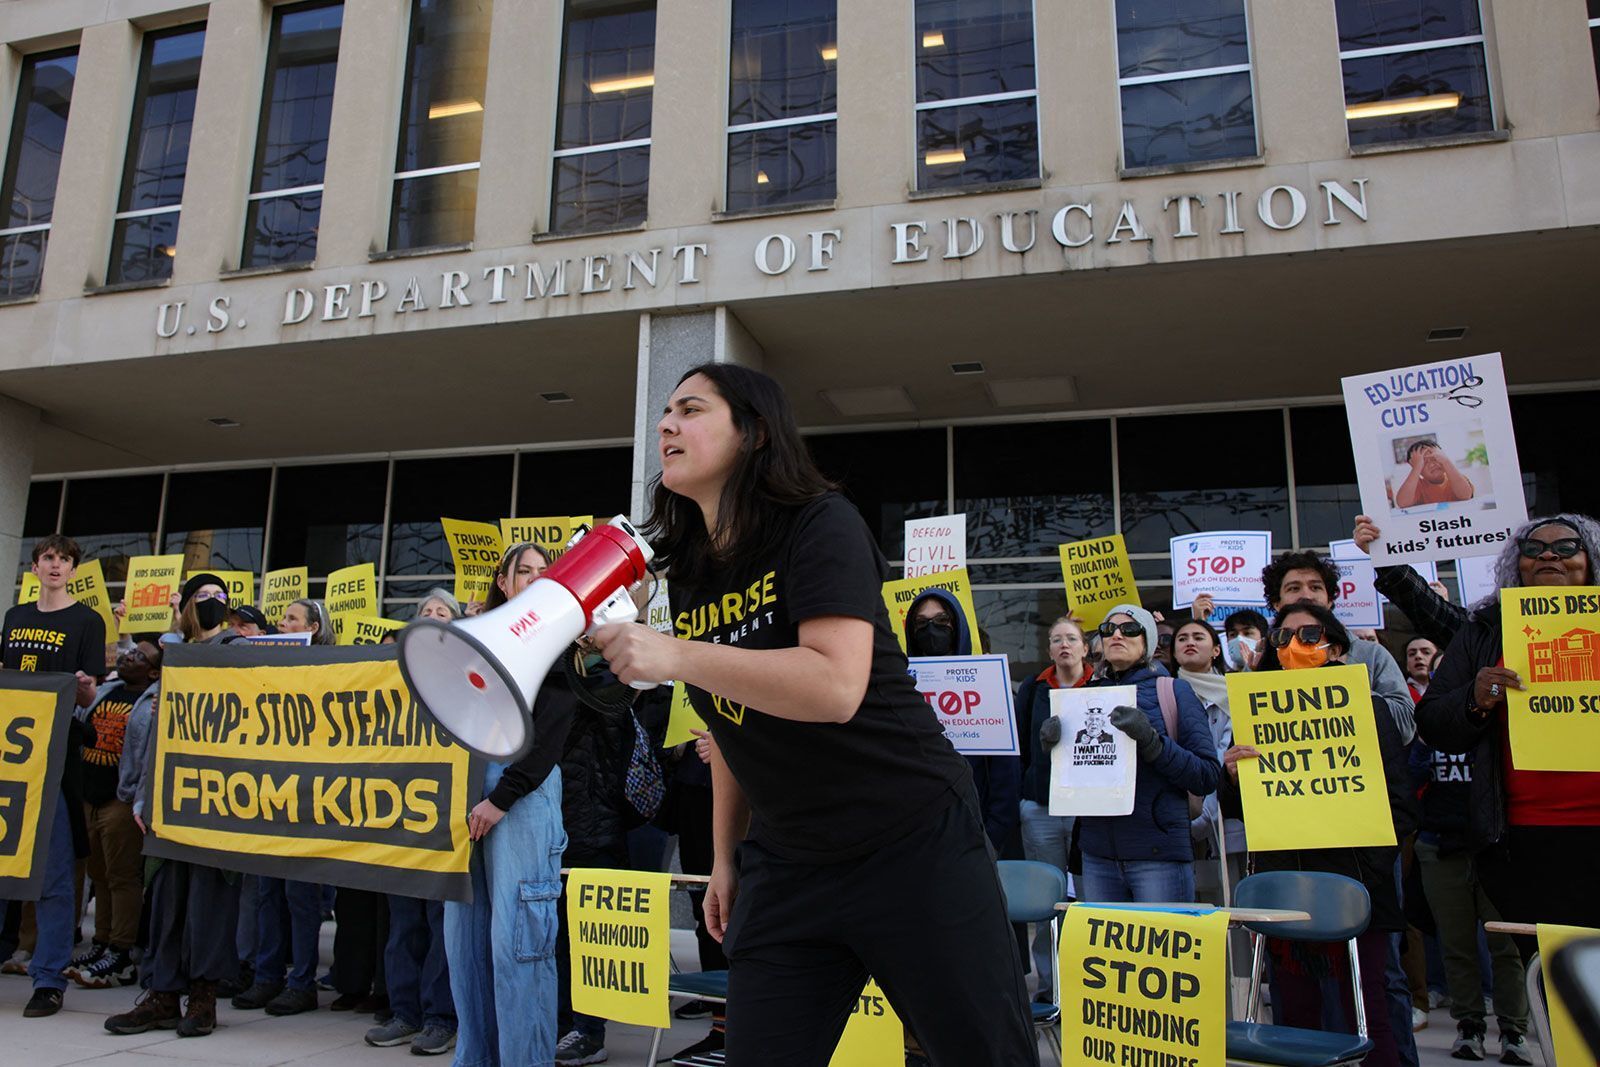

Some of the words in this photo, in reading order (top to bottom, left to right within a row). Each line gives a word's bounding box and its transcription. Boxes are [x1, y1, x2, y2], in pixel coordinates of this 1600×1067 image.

[155, 296, 247, 339] U.S.
[282, 242, 709, 326] DEPARTMENT
[754, 229, 842, 277] OF
[890, 178, 1370, 265] EDUCATION
[1363, 362, 1475, 407] EDUCATION
[1380, 402, 1430, 429] CUTS
[511, 525, 563, 544] FUND
[912, 527, 952, 538] DEFEND
[1418, 515, 1472, 534] Slash
[453, 533, 497, 547] TRUMP:
[1435, 528, 1512, 550] futures!
[458, 548, 501, 563] STOP
[907, 545, 956, 563] CIVIL
[1067, 540, 1115, 560] FUND
[150, 567, 176, 577] DESERVE
[1070, 556, 1119, 576] EDUCATION
[1187, 555, 1246, 577] STOP
[65, 576, 96, 595] REE
[268, 575, 301, 590] FUND
[330, 579, 366, 597] FREE
[1073, 576, 1099, 592] NOT
[1103, 571, 1124, 586] 1%
[266, 589, 302, 601] EDUCATION
[1076, 593, 1097, 605] TAX
[1099, 586, 1127, 601] CUTS
[265, 605, 284, 617] NOT
[329, 598, 367, 614] MAHMOUD
[675, 570, 778, 641] SUNRISE
[1520, 597, 1561, 617] KIDS
[9, 628, 66, 646] SUNRISE
[9, 641, 60, 653] MOVEMENT
[946, 668, 978, 676] PROTECT
[956, 675, 976, 683] KIDS
[922, 690, 982, 716] TOP
[1248, 685, 1350, 716] FUND
[1528, 695, 1575, 714] GOOD
[166, 690, 249, 746] TRUMP:
[256, 693, 316, 747] STOP
[952, 717, 1005, 727] EDUCATION!
[1253, 715, 1356, 745] EDUCATION
[1074, 745, 1077, 754] I
[1078, 745, 1100, 754] WANT
[1101, 743, 1116, 753] YOU
[1257, 749, 1313, 774] NOT
[1322, 744, 1361, 770] 1%
[1262, 779, 1305, 797] TAX
[1310, 775, 1366, 794] CUTS
[173, 766, 300, 824] FROM
[312, 776, 440, 834] KIDS
[579, 884, 651, 913] FREE
[579, 920, 649, 949] MAHMOUD
[1087, 917, 1201, 960] TRUMP:
[581, 955, 649, 994] KHALIL
[1082, 956, 1201, 1004] STOP
[1082, 997, 1200, 1047] DEFUNDING
[1082, 1035, 1116, 1064] OUR
